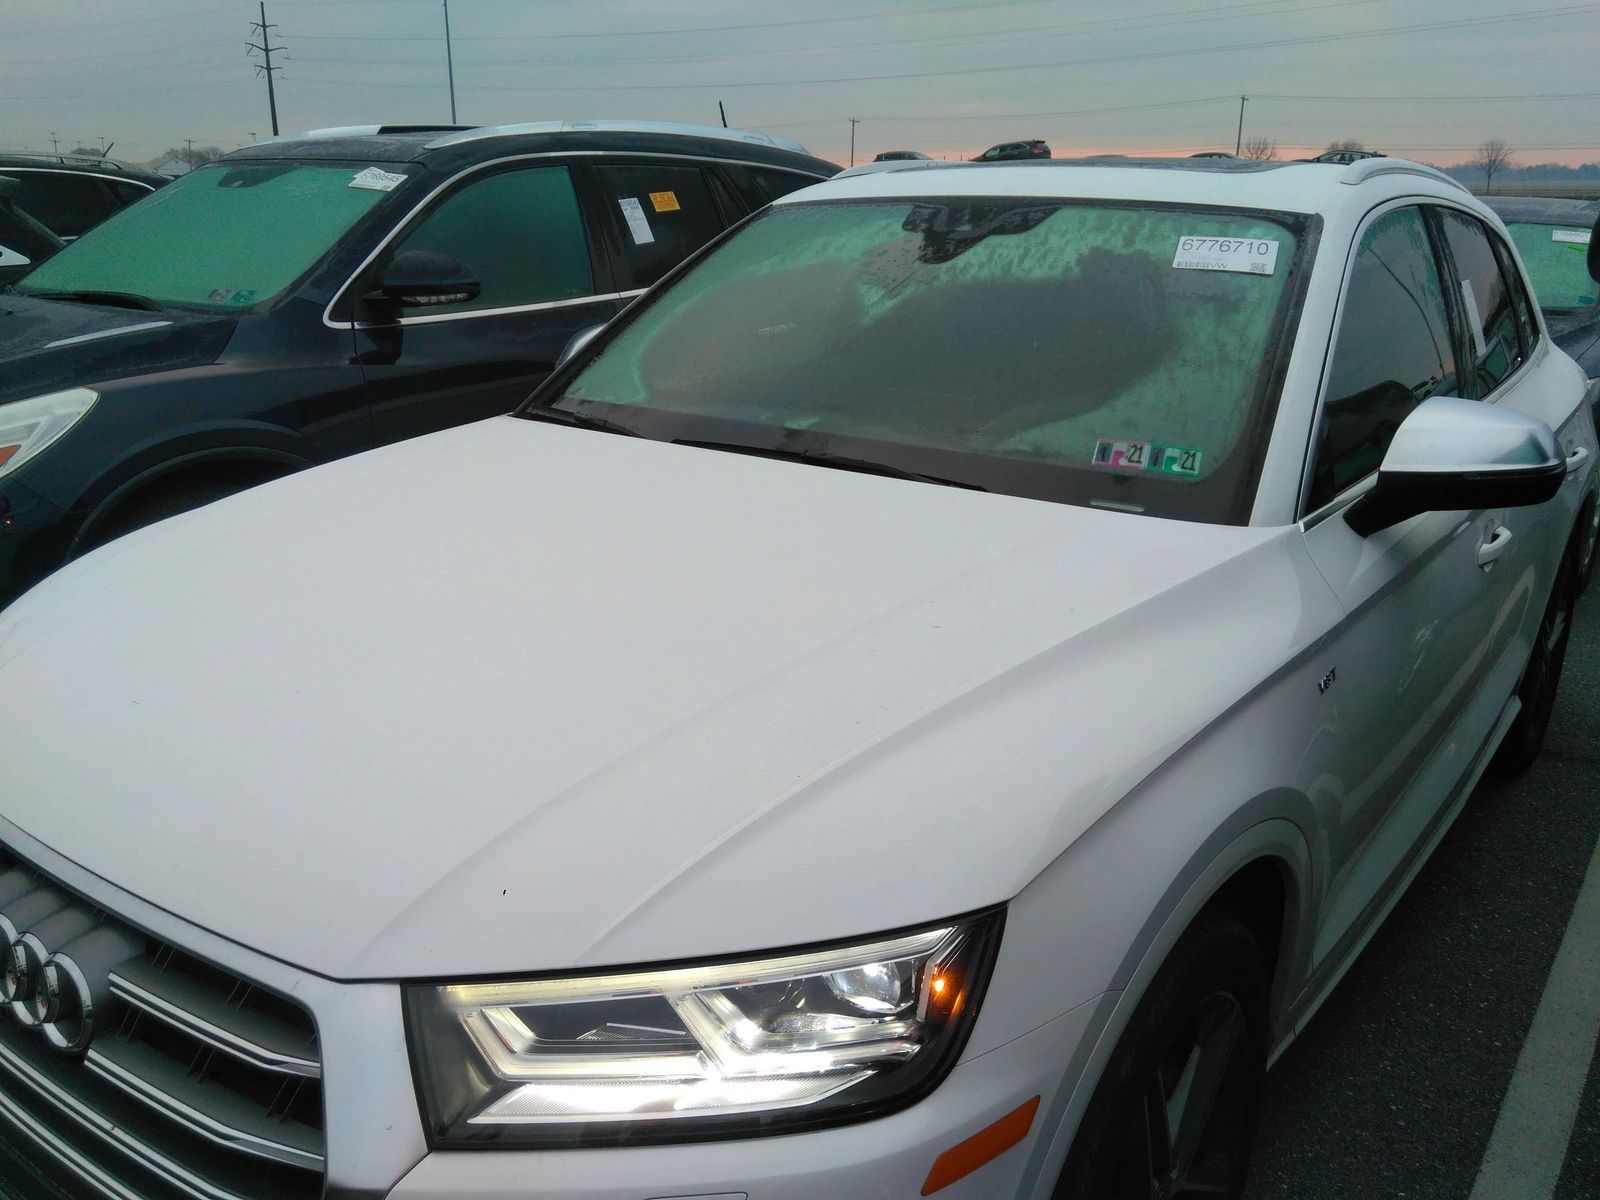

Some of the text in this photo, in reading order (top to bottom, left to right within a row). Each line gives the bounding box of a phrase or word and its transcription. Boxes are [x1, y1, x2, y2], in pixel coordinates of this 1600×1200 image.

[1182, 239, 1269, 256] 6776710
[1128, 444, 1145, 464] 21
[1181, 451, 1197, 471] 21
